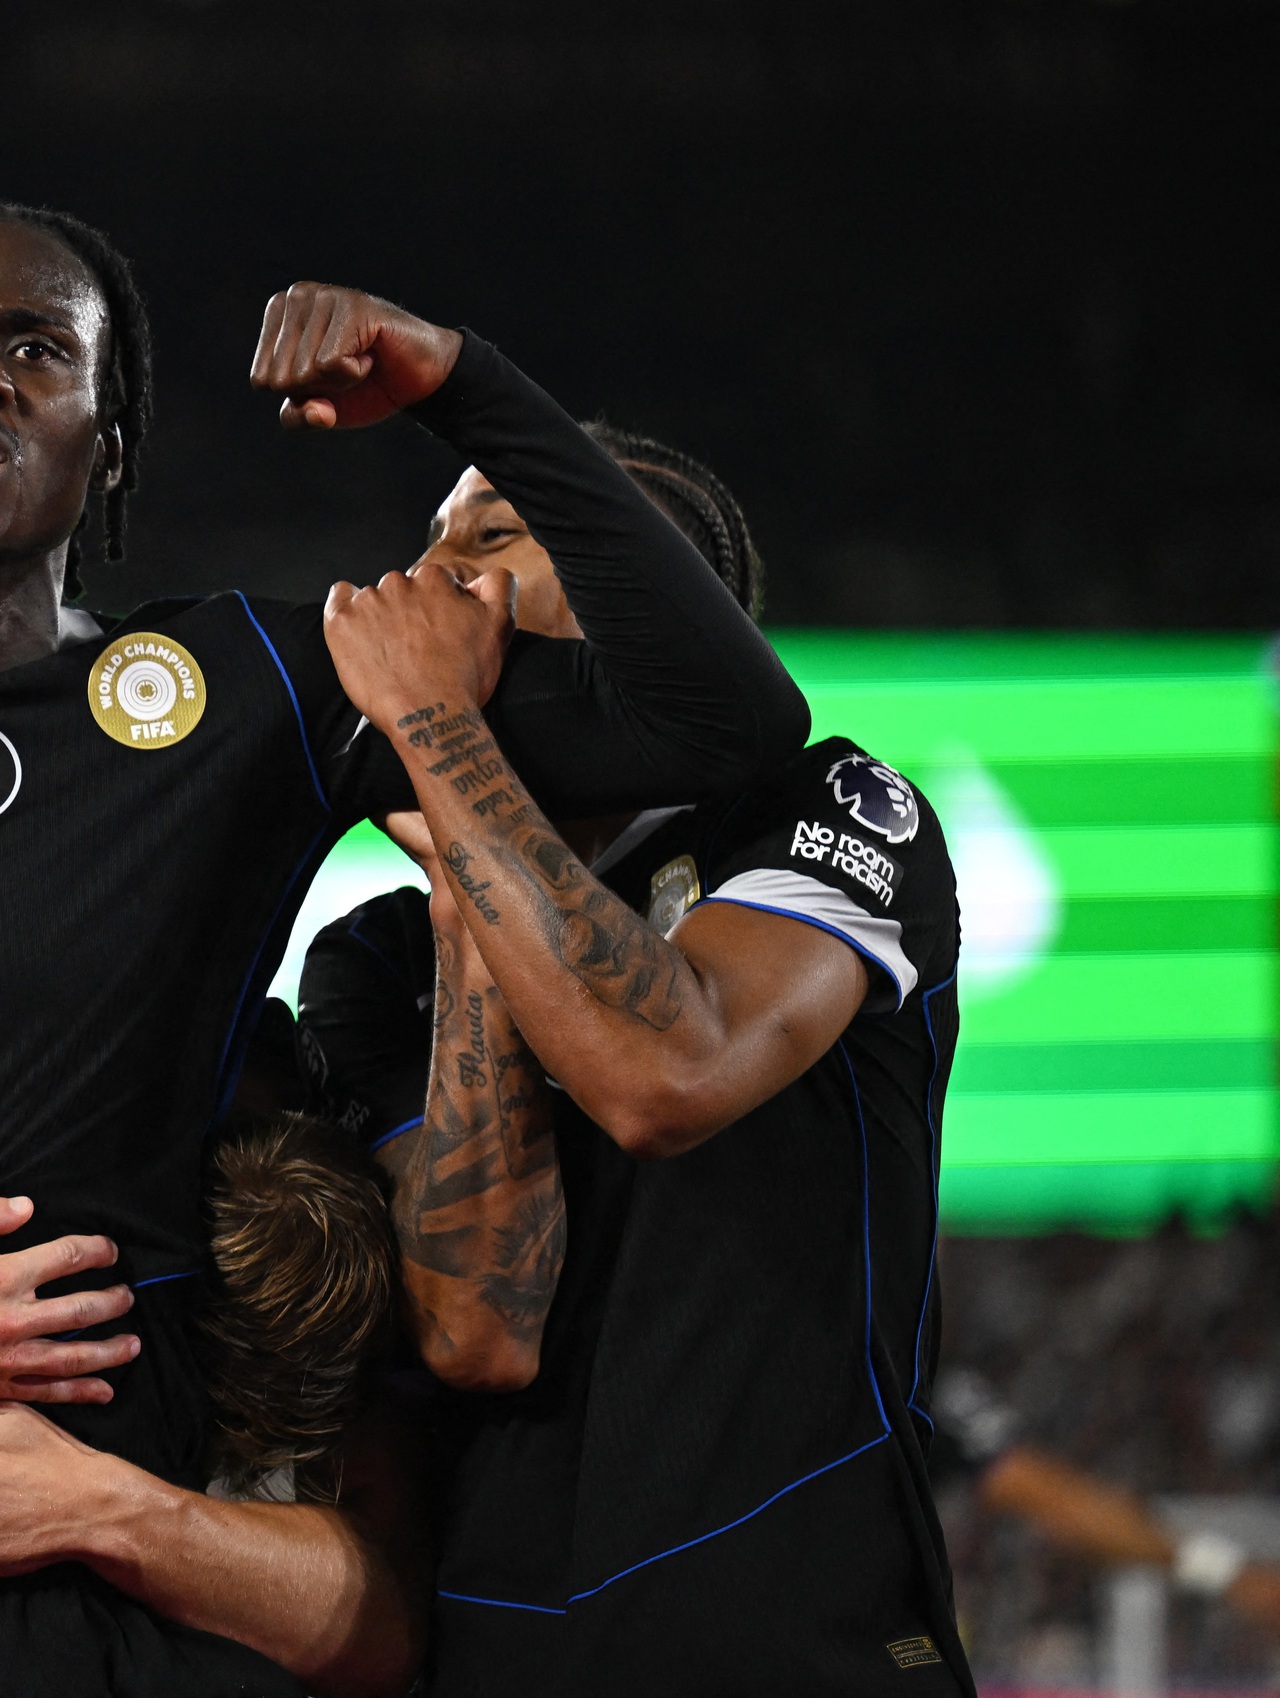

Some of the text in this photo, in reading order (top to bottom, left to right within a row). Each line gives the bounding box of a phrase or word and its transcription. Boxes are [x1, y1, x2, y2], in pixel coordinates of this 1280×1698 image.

[98, 643, 195, 710] WORLD CHAMPIONS
[129, 721, 176, 741] FIFA
[790, 836, 894, 907] for racism
[794, 820, 895, 883] No room
